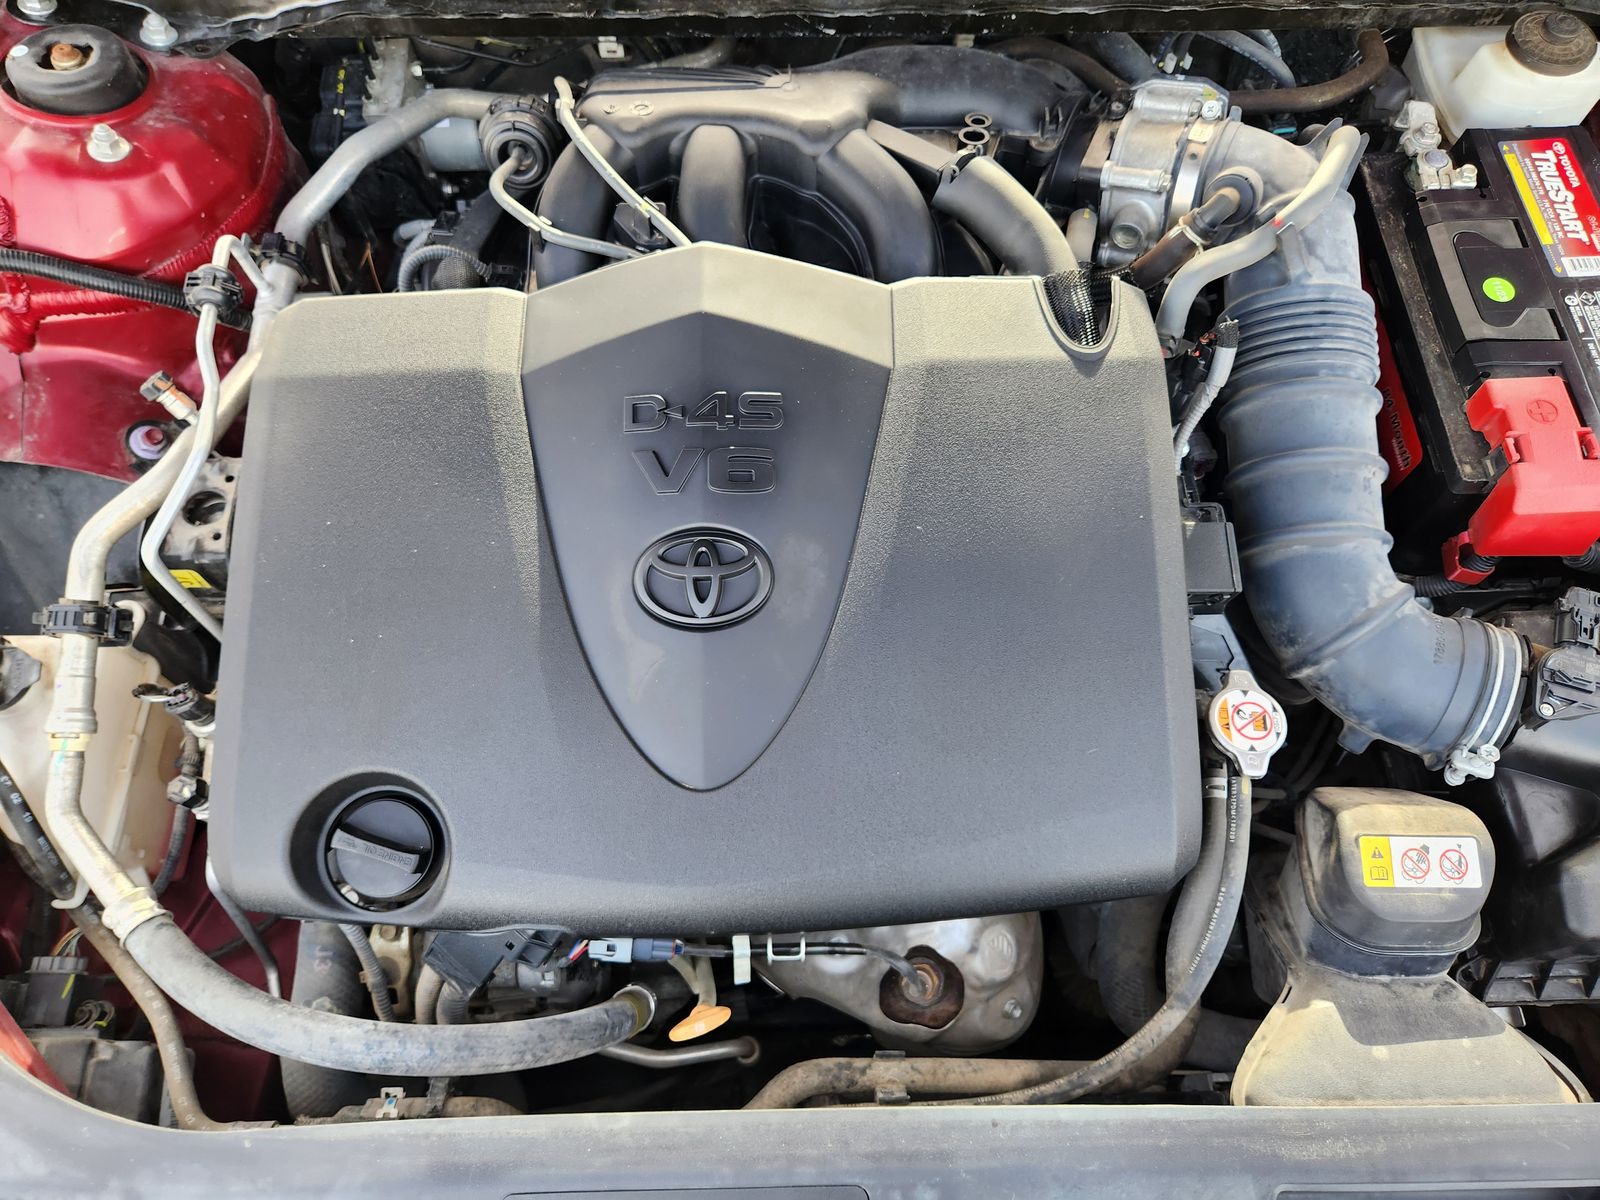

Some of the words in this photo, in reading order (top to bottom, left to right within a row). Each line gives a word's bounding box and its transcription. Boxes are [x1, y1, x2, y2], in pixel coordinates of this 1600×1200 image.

[1559, 154, 1581, 188] TOYOTA
[1390, 412, 1412, 468] Month
[632, 446, 776, 495] V6
